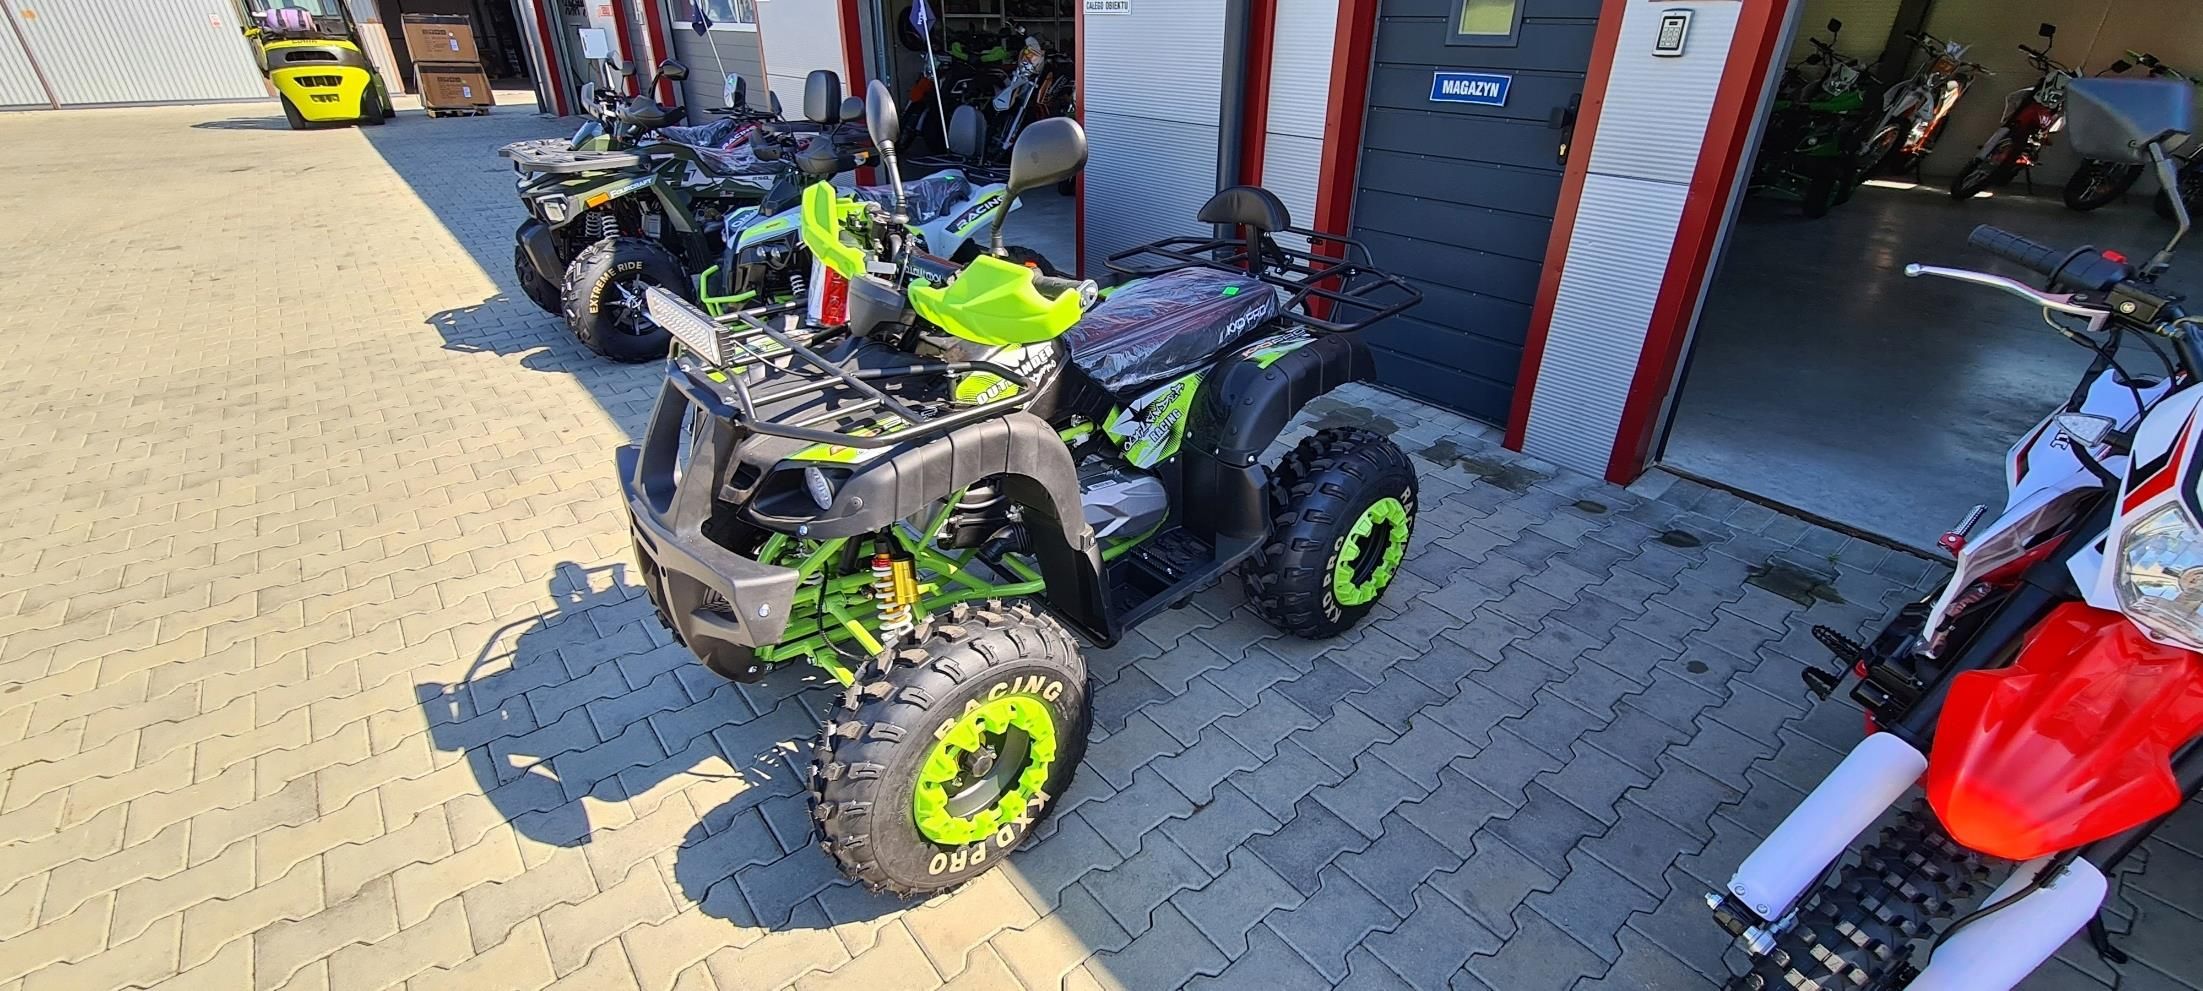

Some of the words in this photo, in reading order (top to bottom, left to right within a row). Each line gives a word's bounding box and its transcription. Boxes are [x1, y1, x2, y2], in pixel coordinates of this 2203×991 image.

[1105, 1, 1129, 10] OBIEKTU
[1442, 79, 1500, 98] MAGAZYN
[722, 126, 752, 150] RACIN
[610, 177, 653, 197] FOURCRAFT
[589, 267, 617, 314] EXTREME
[616, 261, 642, 273] RIDE
[1226, 316, 1246, 336] KXD
[1246, 304, 1267, 323] PRO
[976, 345, 1055, 405] OUTNDER
[1150, 408, 1182, 442] RACING
[1323, 535, 1345, 588] PRO
[1322, 591, 1343, 624] KXD
[928, 842, 987, 875] PRO
